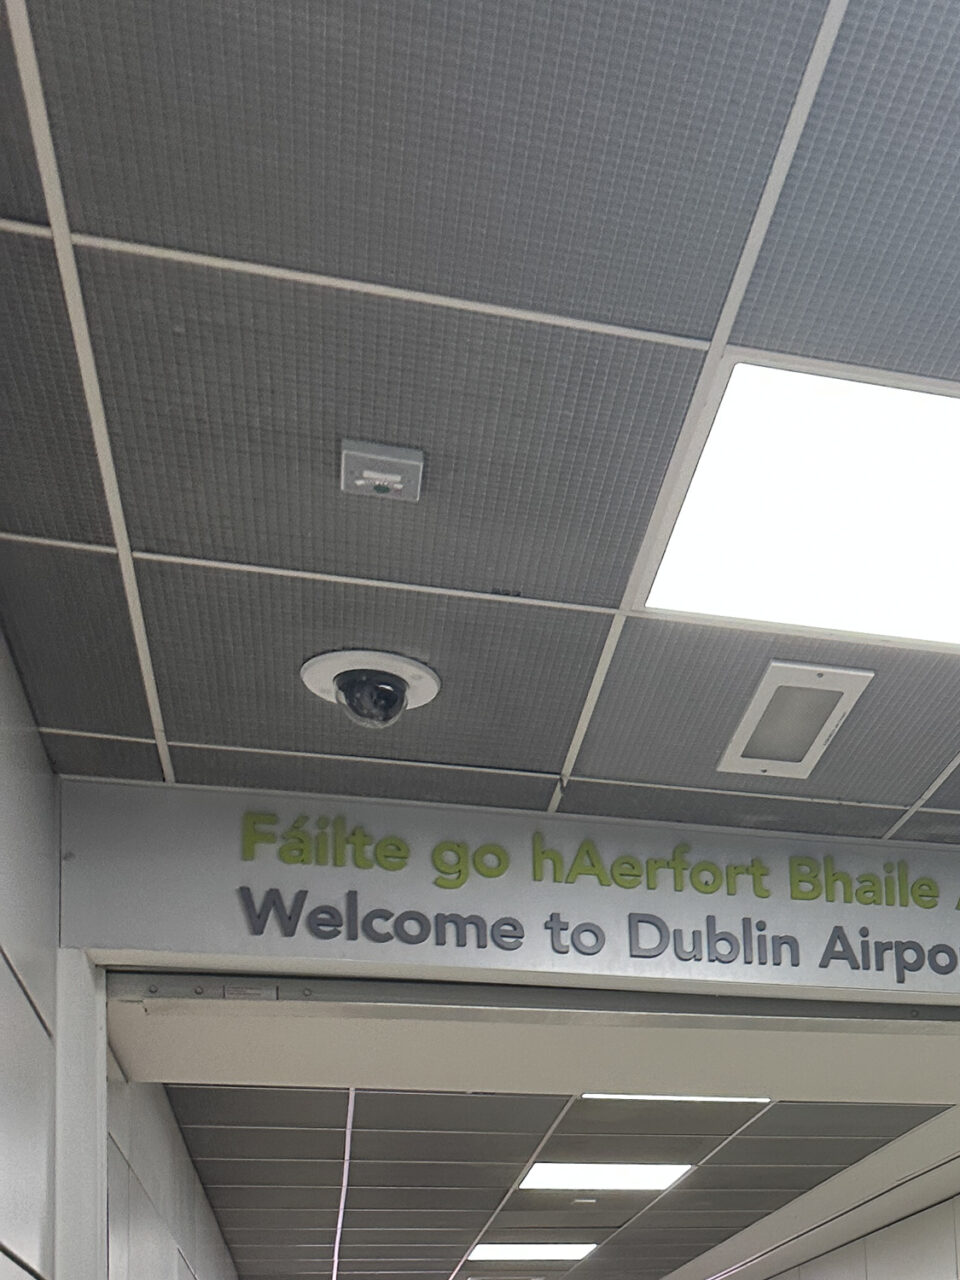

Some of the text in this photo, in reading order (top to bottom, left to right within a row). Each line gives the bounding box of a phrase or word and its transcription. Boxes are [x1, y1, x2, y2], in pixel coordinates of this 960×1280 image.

[241, 811, 410, 871] Fáilte
[431, 840, 509, 889] go
[532, 831, 771, 898] hAerfort
[788, 856, 939, 909] Bhaile
[238, 886, 524, 951] Welcome
[545, 912, 606, 956] to
[628, 912, 800, 967] Dublin
